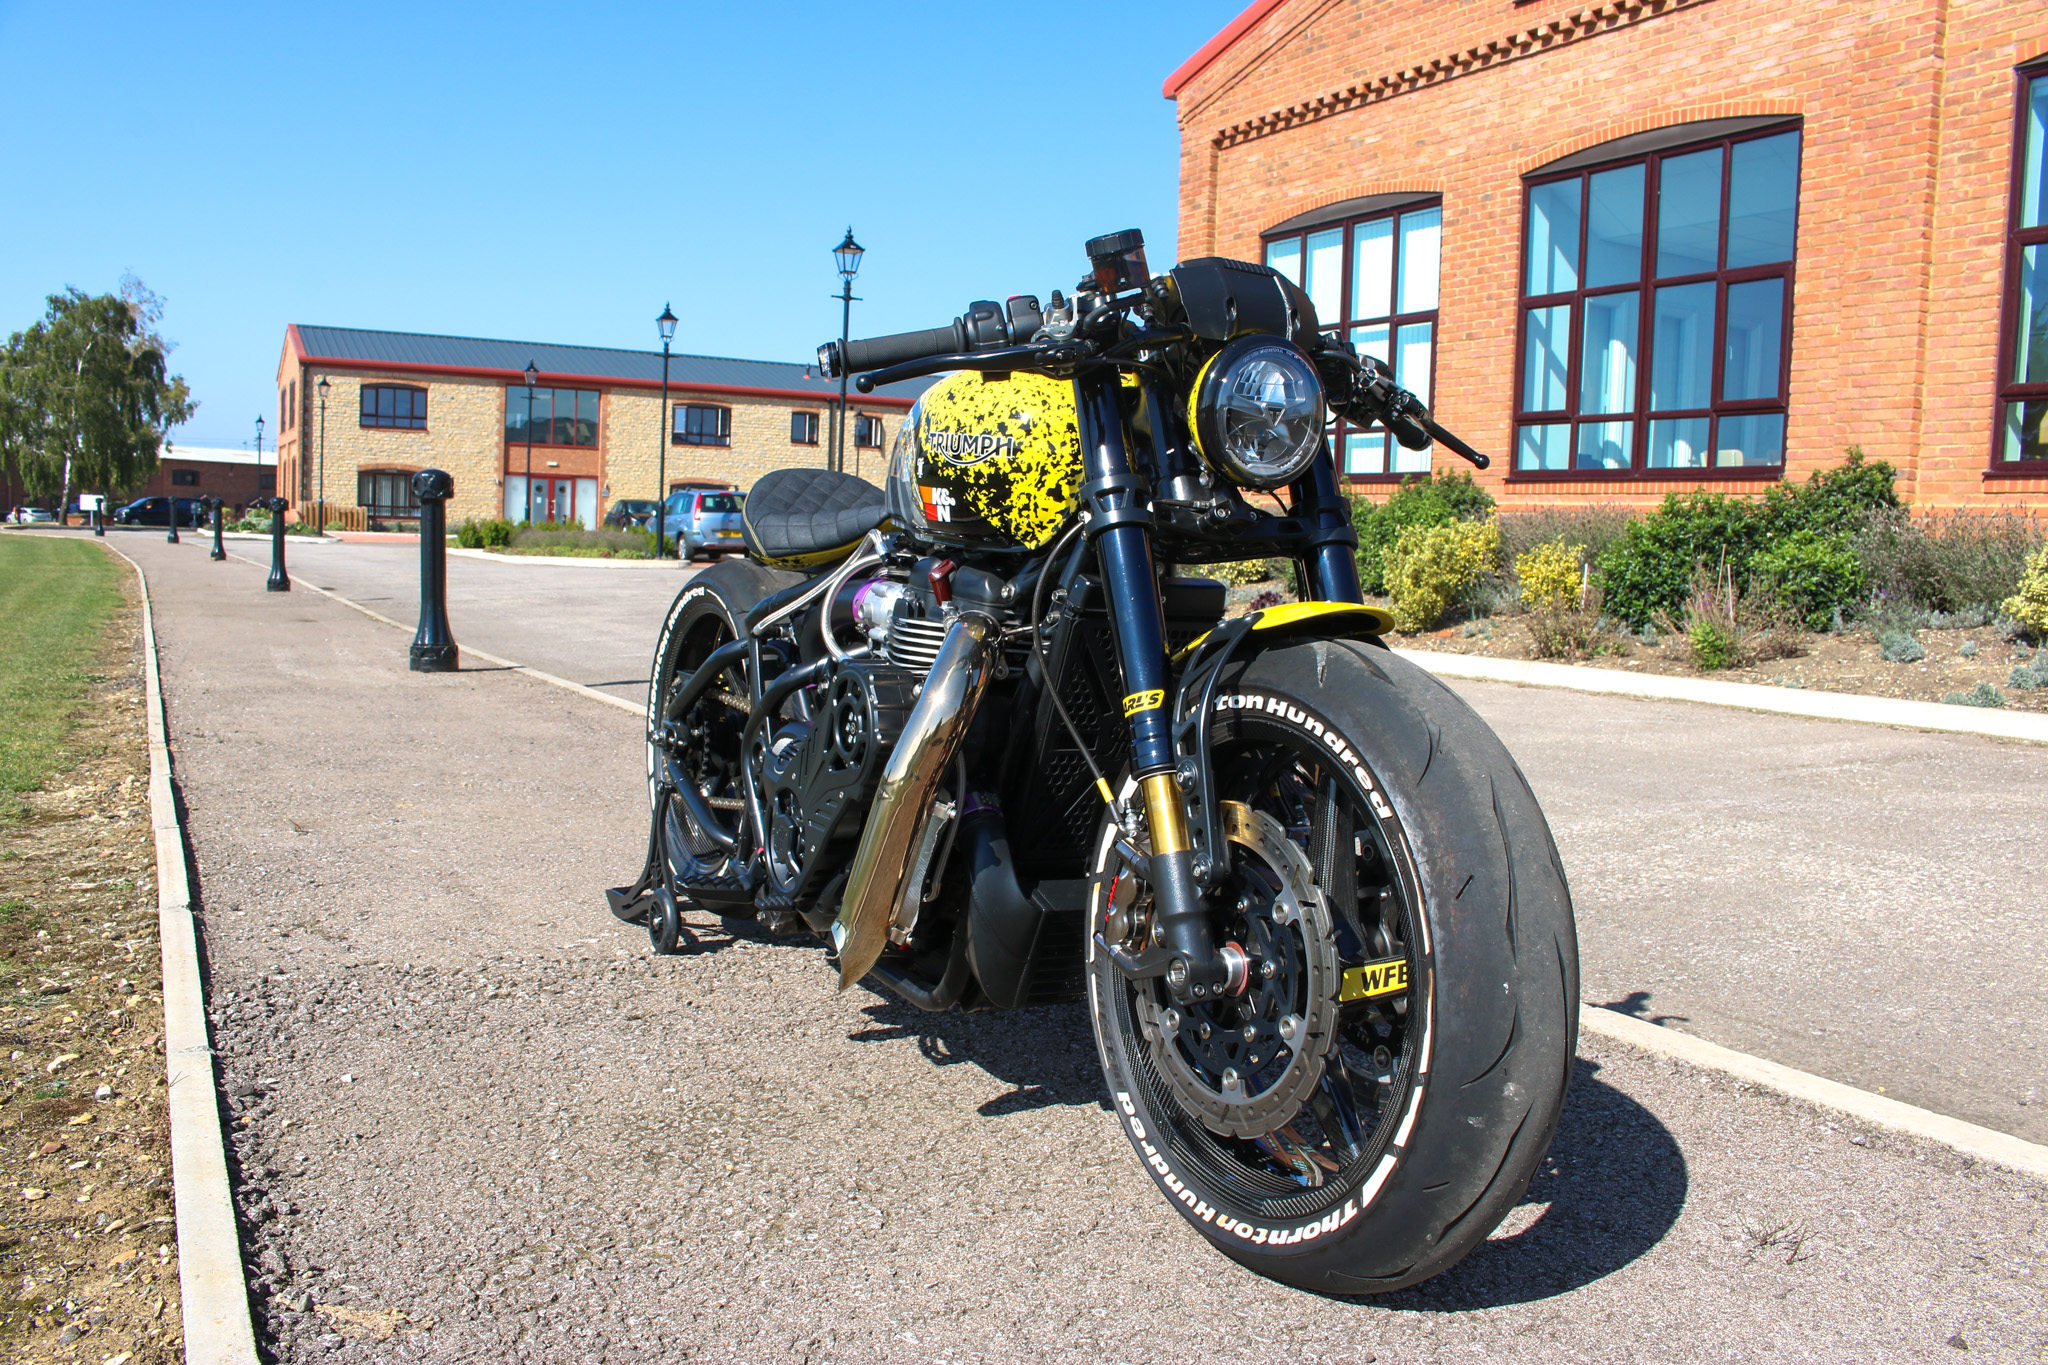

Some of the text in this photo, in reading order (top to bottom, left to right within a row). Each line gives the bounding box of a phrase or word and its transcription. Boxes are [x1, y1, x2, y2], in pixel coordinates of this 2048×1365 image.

[928, 432, 1014, 464] TRIUMPH
[936, 505, 951, 522] N
[667, 586, 705, 631] Hundred
[1266, 697, 1393, 819] Hundred
[1116, 1091, 1359, 1246] Thornton Hundred
